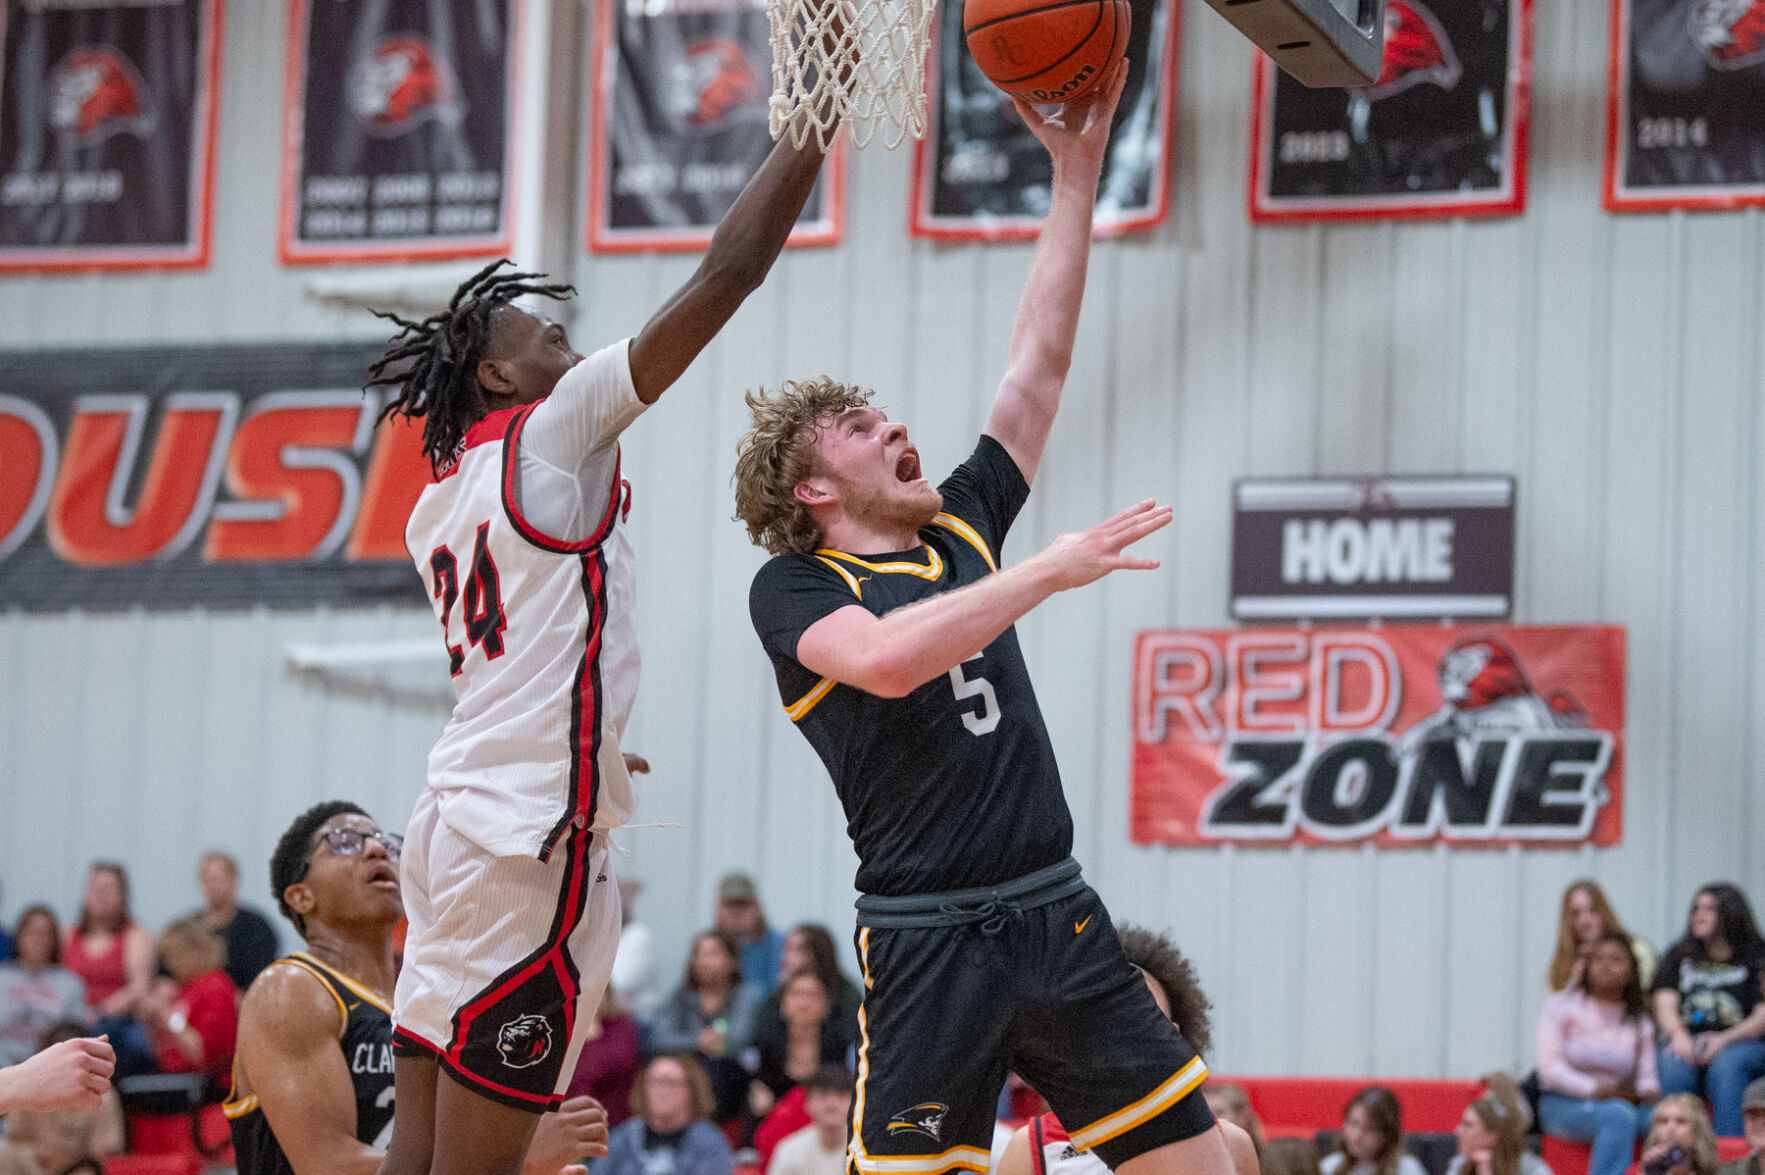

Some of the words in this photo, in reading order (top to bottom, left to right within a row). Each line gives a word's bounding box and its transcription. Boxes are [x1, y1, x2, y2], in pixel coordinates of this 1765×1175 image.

[1637, 117, 1708, 148] 2014
[1281, 518, 1456, 584] HOME
[430, 519, 507, 678] 24
[948, 649, 1002, 737] 5
[1135, 631, 1403, 743] RED
[1200, 731, 1612, 839] ZONE
[352, 1042, 395, 1074] CLA
